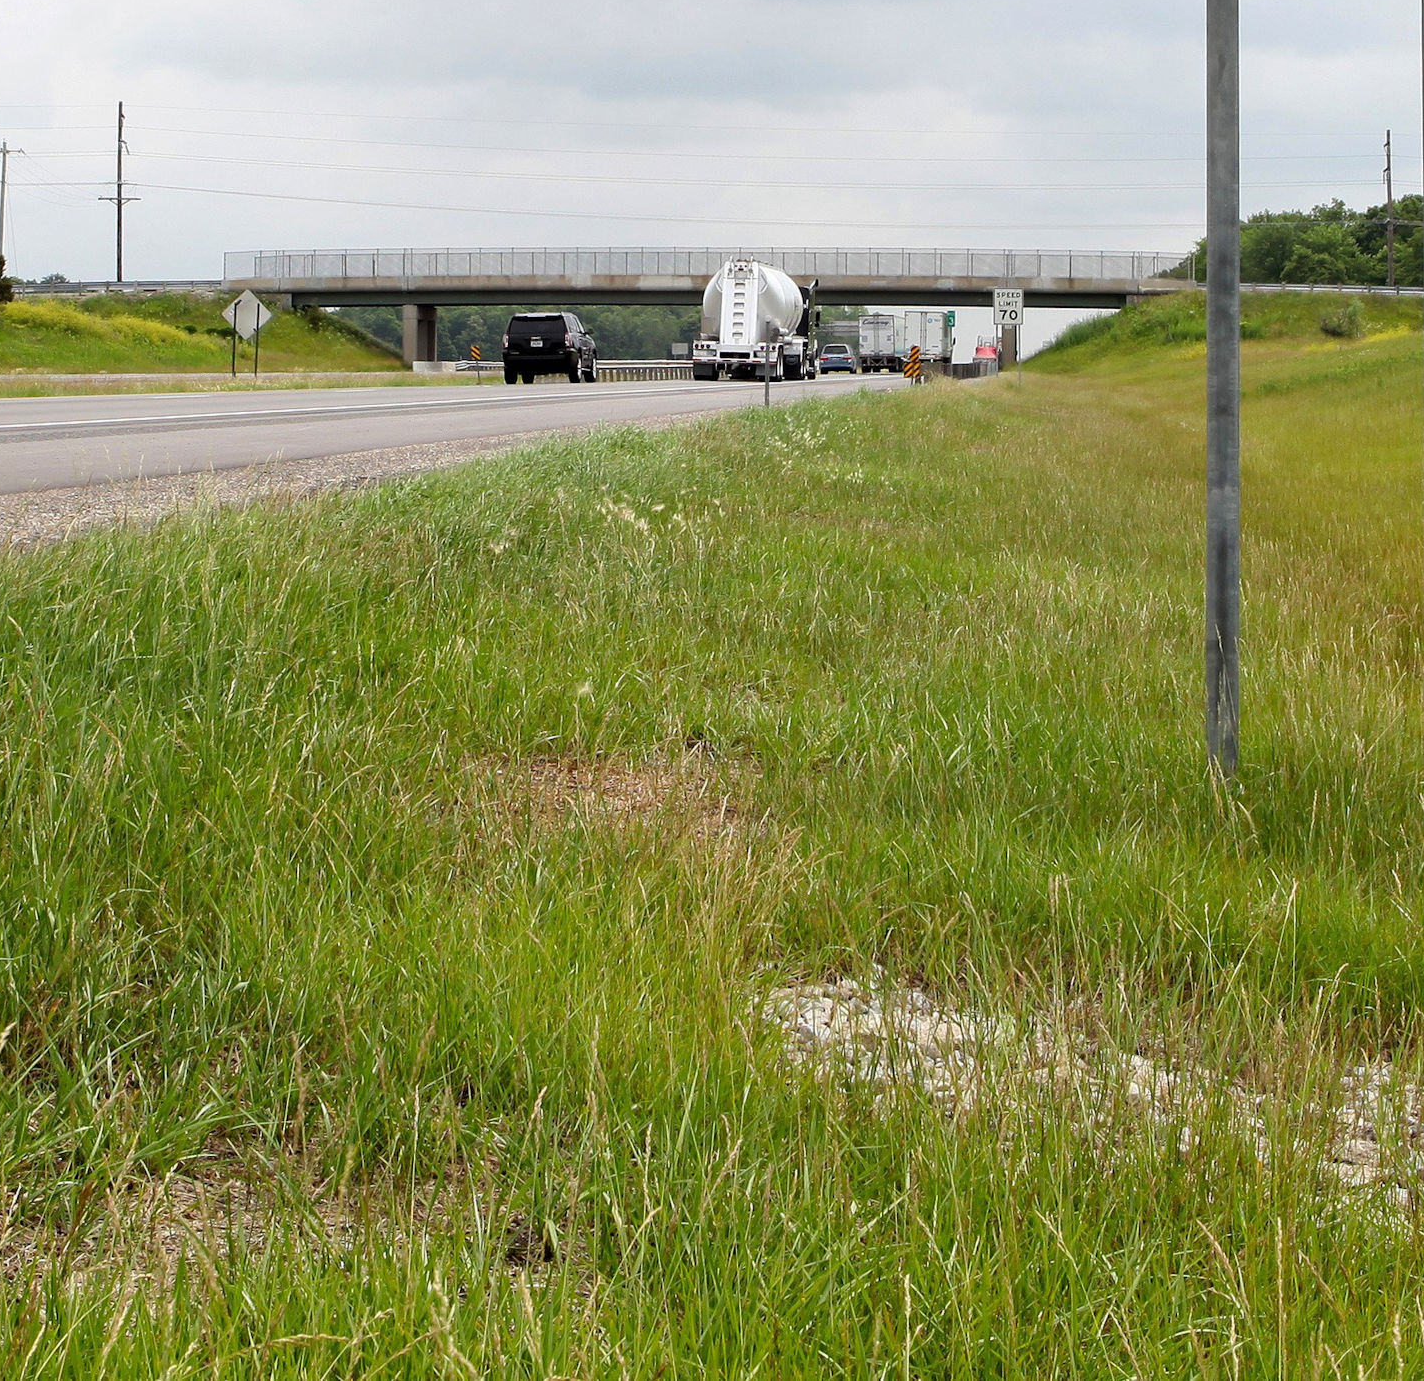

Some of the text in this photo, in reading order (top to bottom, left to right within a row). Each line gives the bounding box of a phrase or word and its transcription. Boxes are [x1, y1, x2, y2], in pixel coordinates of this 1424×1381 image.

[996, 291, 1021, 299] SPEED
[998, 300, 1019, 308] LIMIT
[999, 309, 1018, 321] 70
